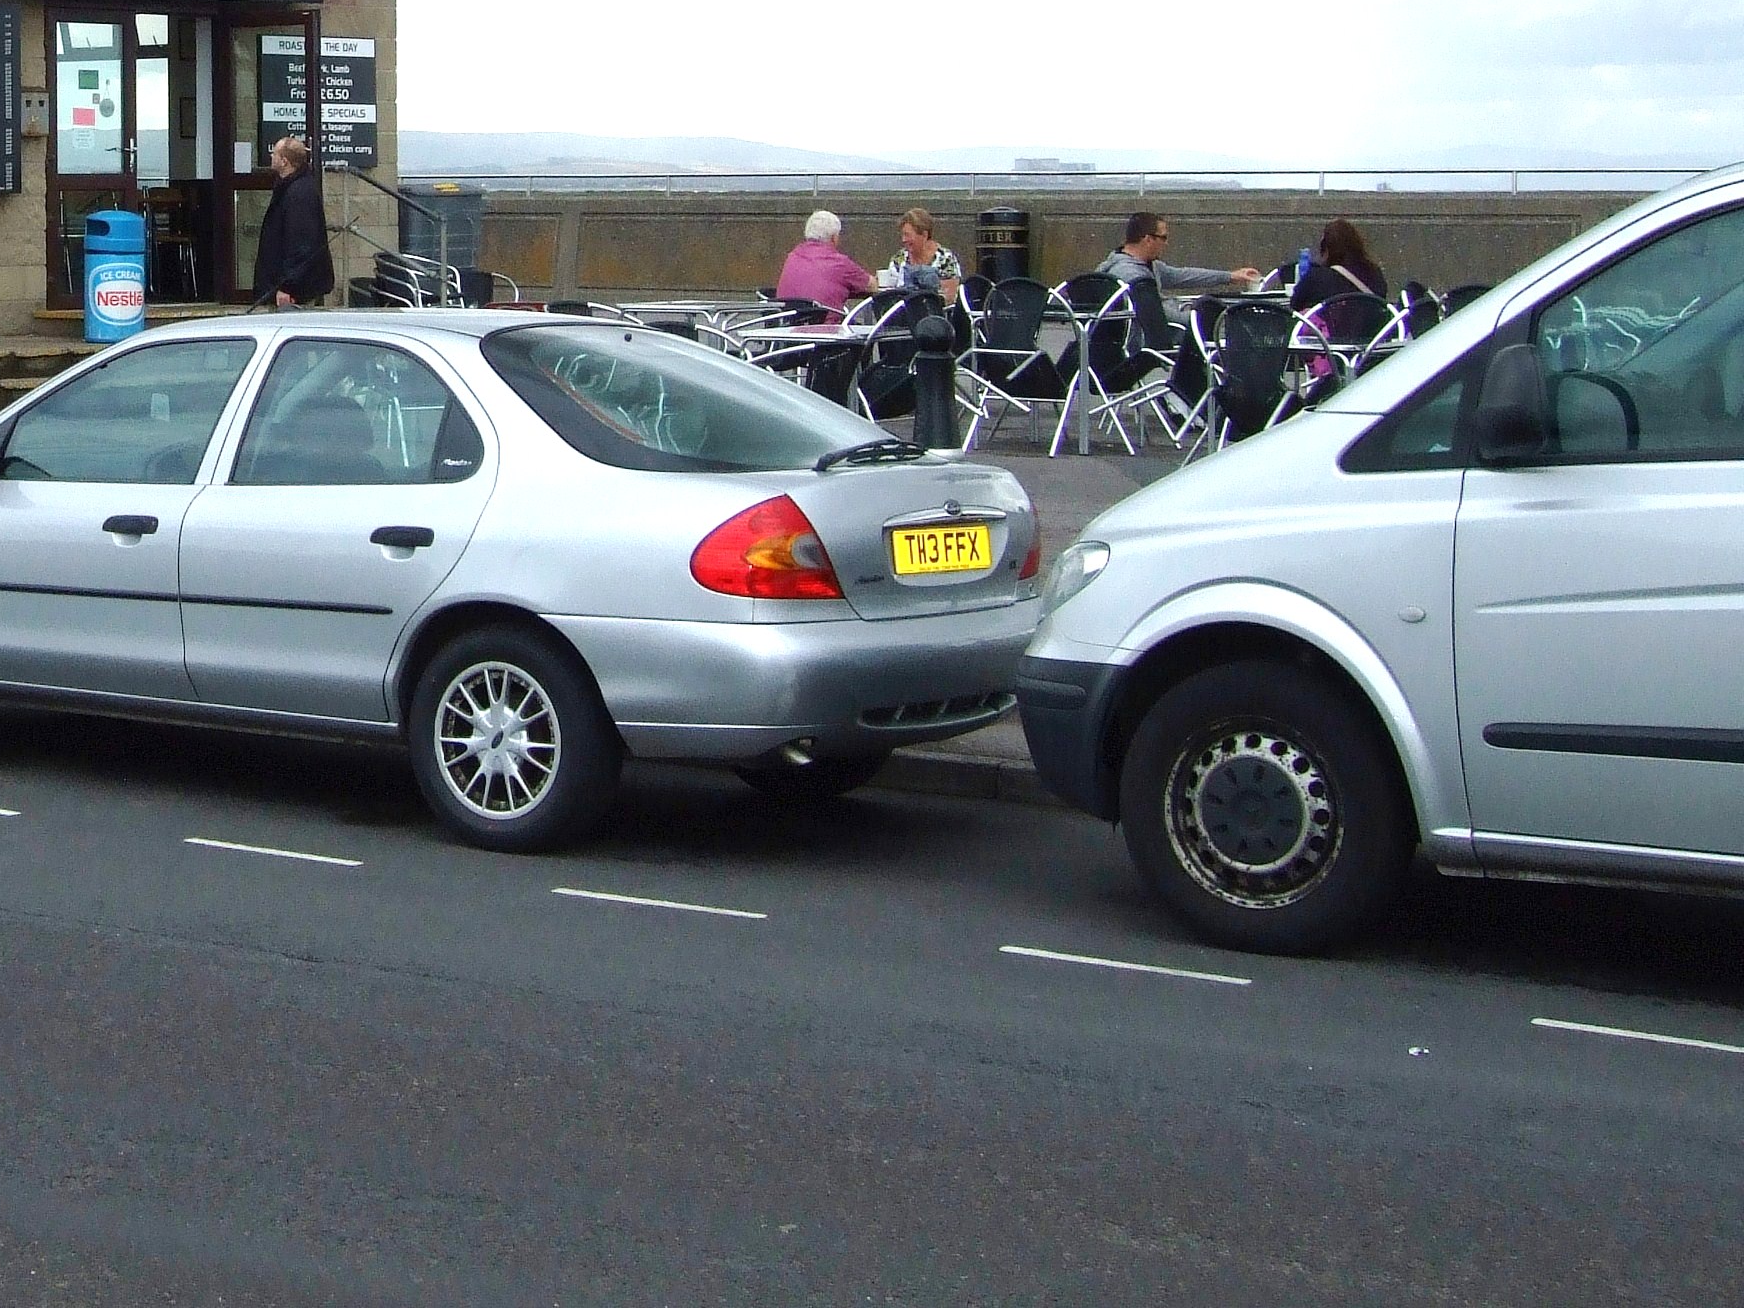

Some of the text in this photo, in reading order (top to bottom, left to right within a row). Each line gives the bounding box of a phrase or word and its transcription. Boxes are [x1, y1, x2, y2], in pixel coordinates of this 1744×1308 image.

[278, 40, 359, 53] ROAS THE DAY
[330, 64, 350, 74] Lamb
[286, 75, 353, 87] Turke Chicken
[290, 87, 307, 100] Fro
[273, 107, 298, 117] HOME
[327, 108, 367, 119] SPECIALS
[99, 270, 141, 281] ICE CREAM
[904, 531, 981, 565] TH3 FFX
